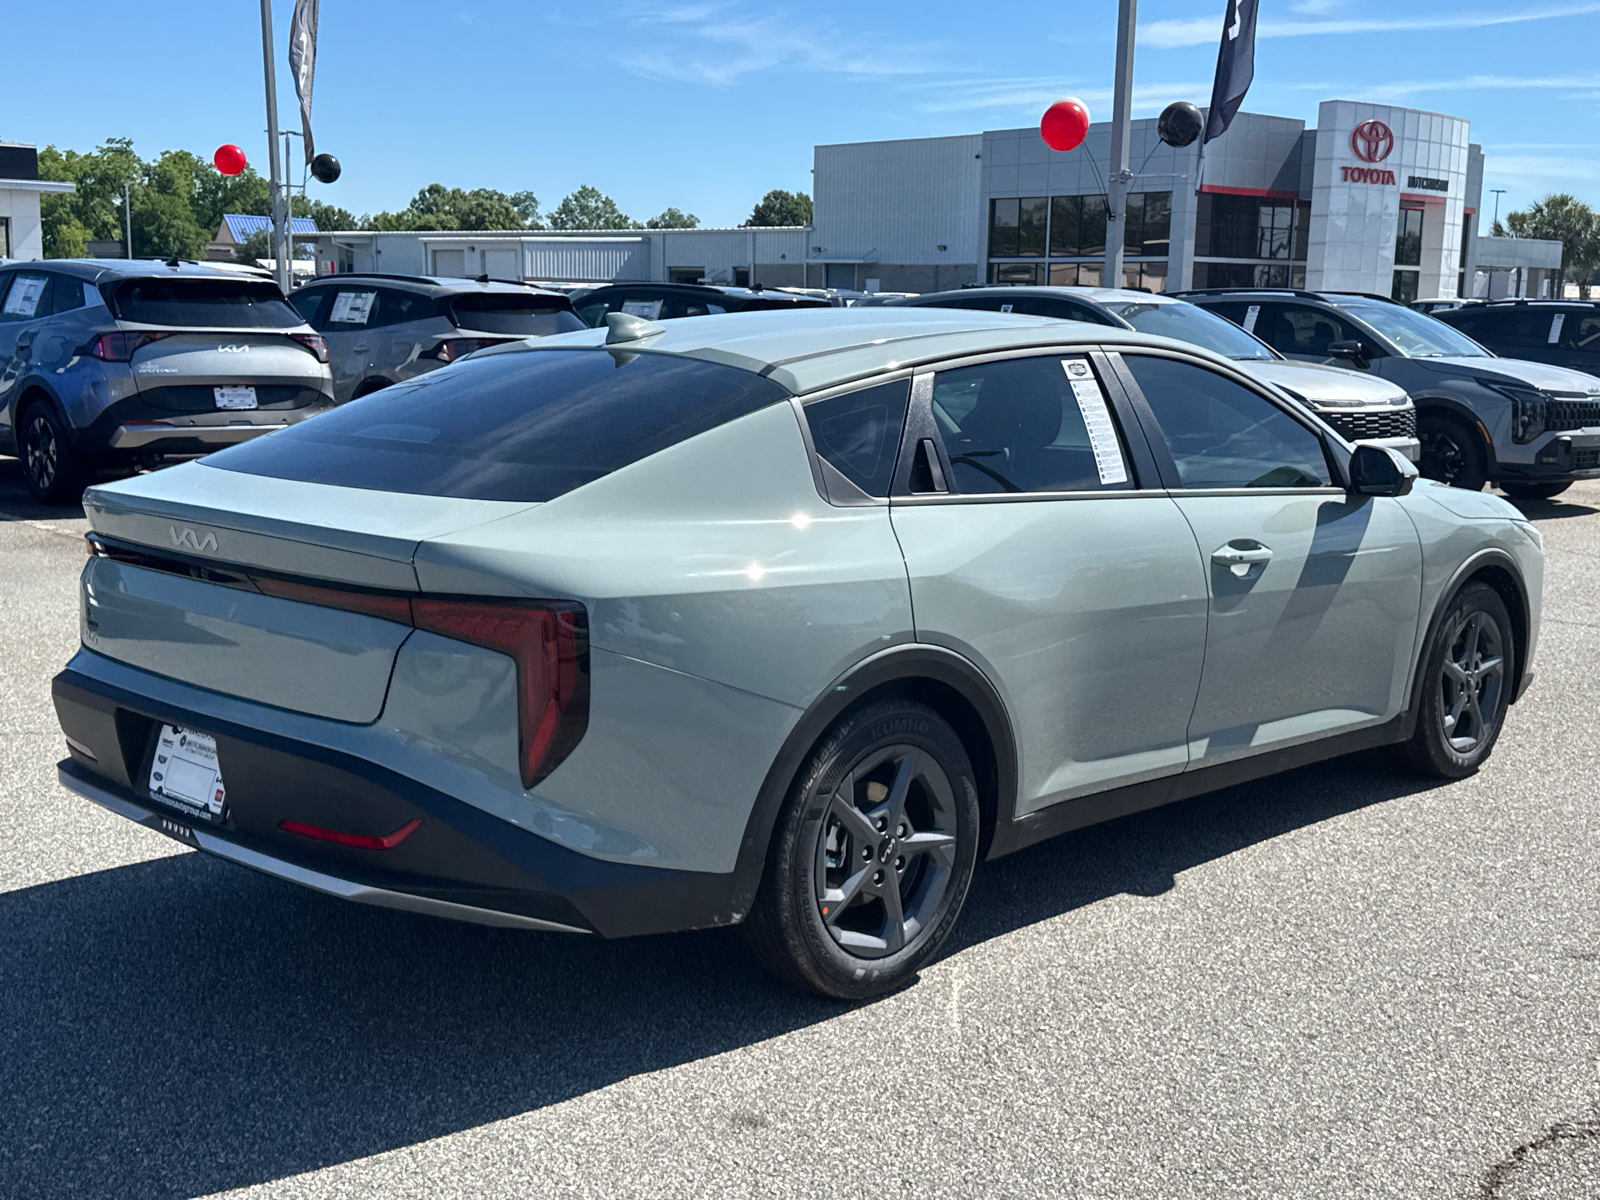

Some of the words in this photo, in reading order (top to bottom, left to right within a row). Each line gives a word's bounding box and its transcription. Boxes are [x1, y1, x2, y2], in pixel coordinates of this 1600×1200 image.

[1341, 166, 1396, 186] TOYOTA
[1407, 176, 1449, 192] HUTCHINSON
[217, 344, 249, 353] KIA
[170, 525, 219, 552] KIA
[871, 718, 929, 741] KUMHO
